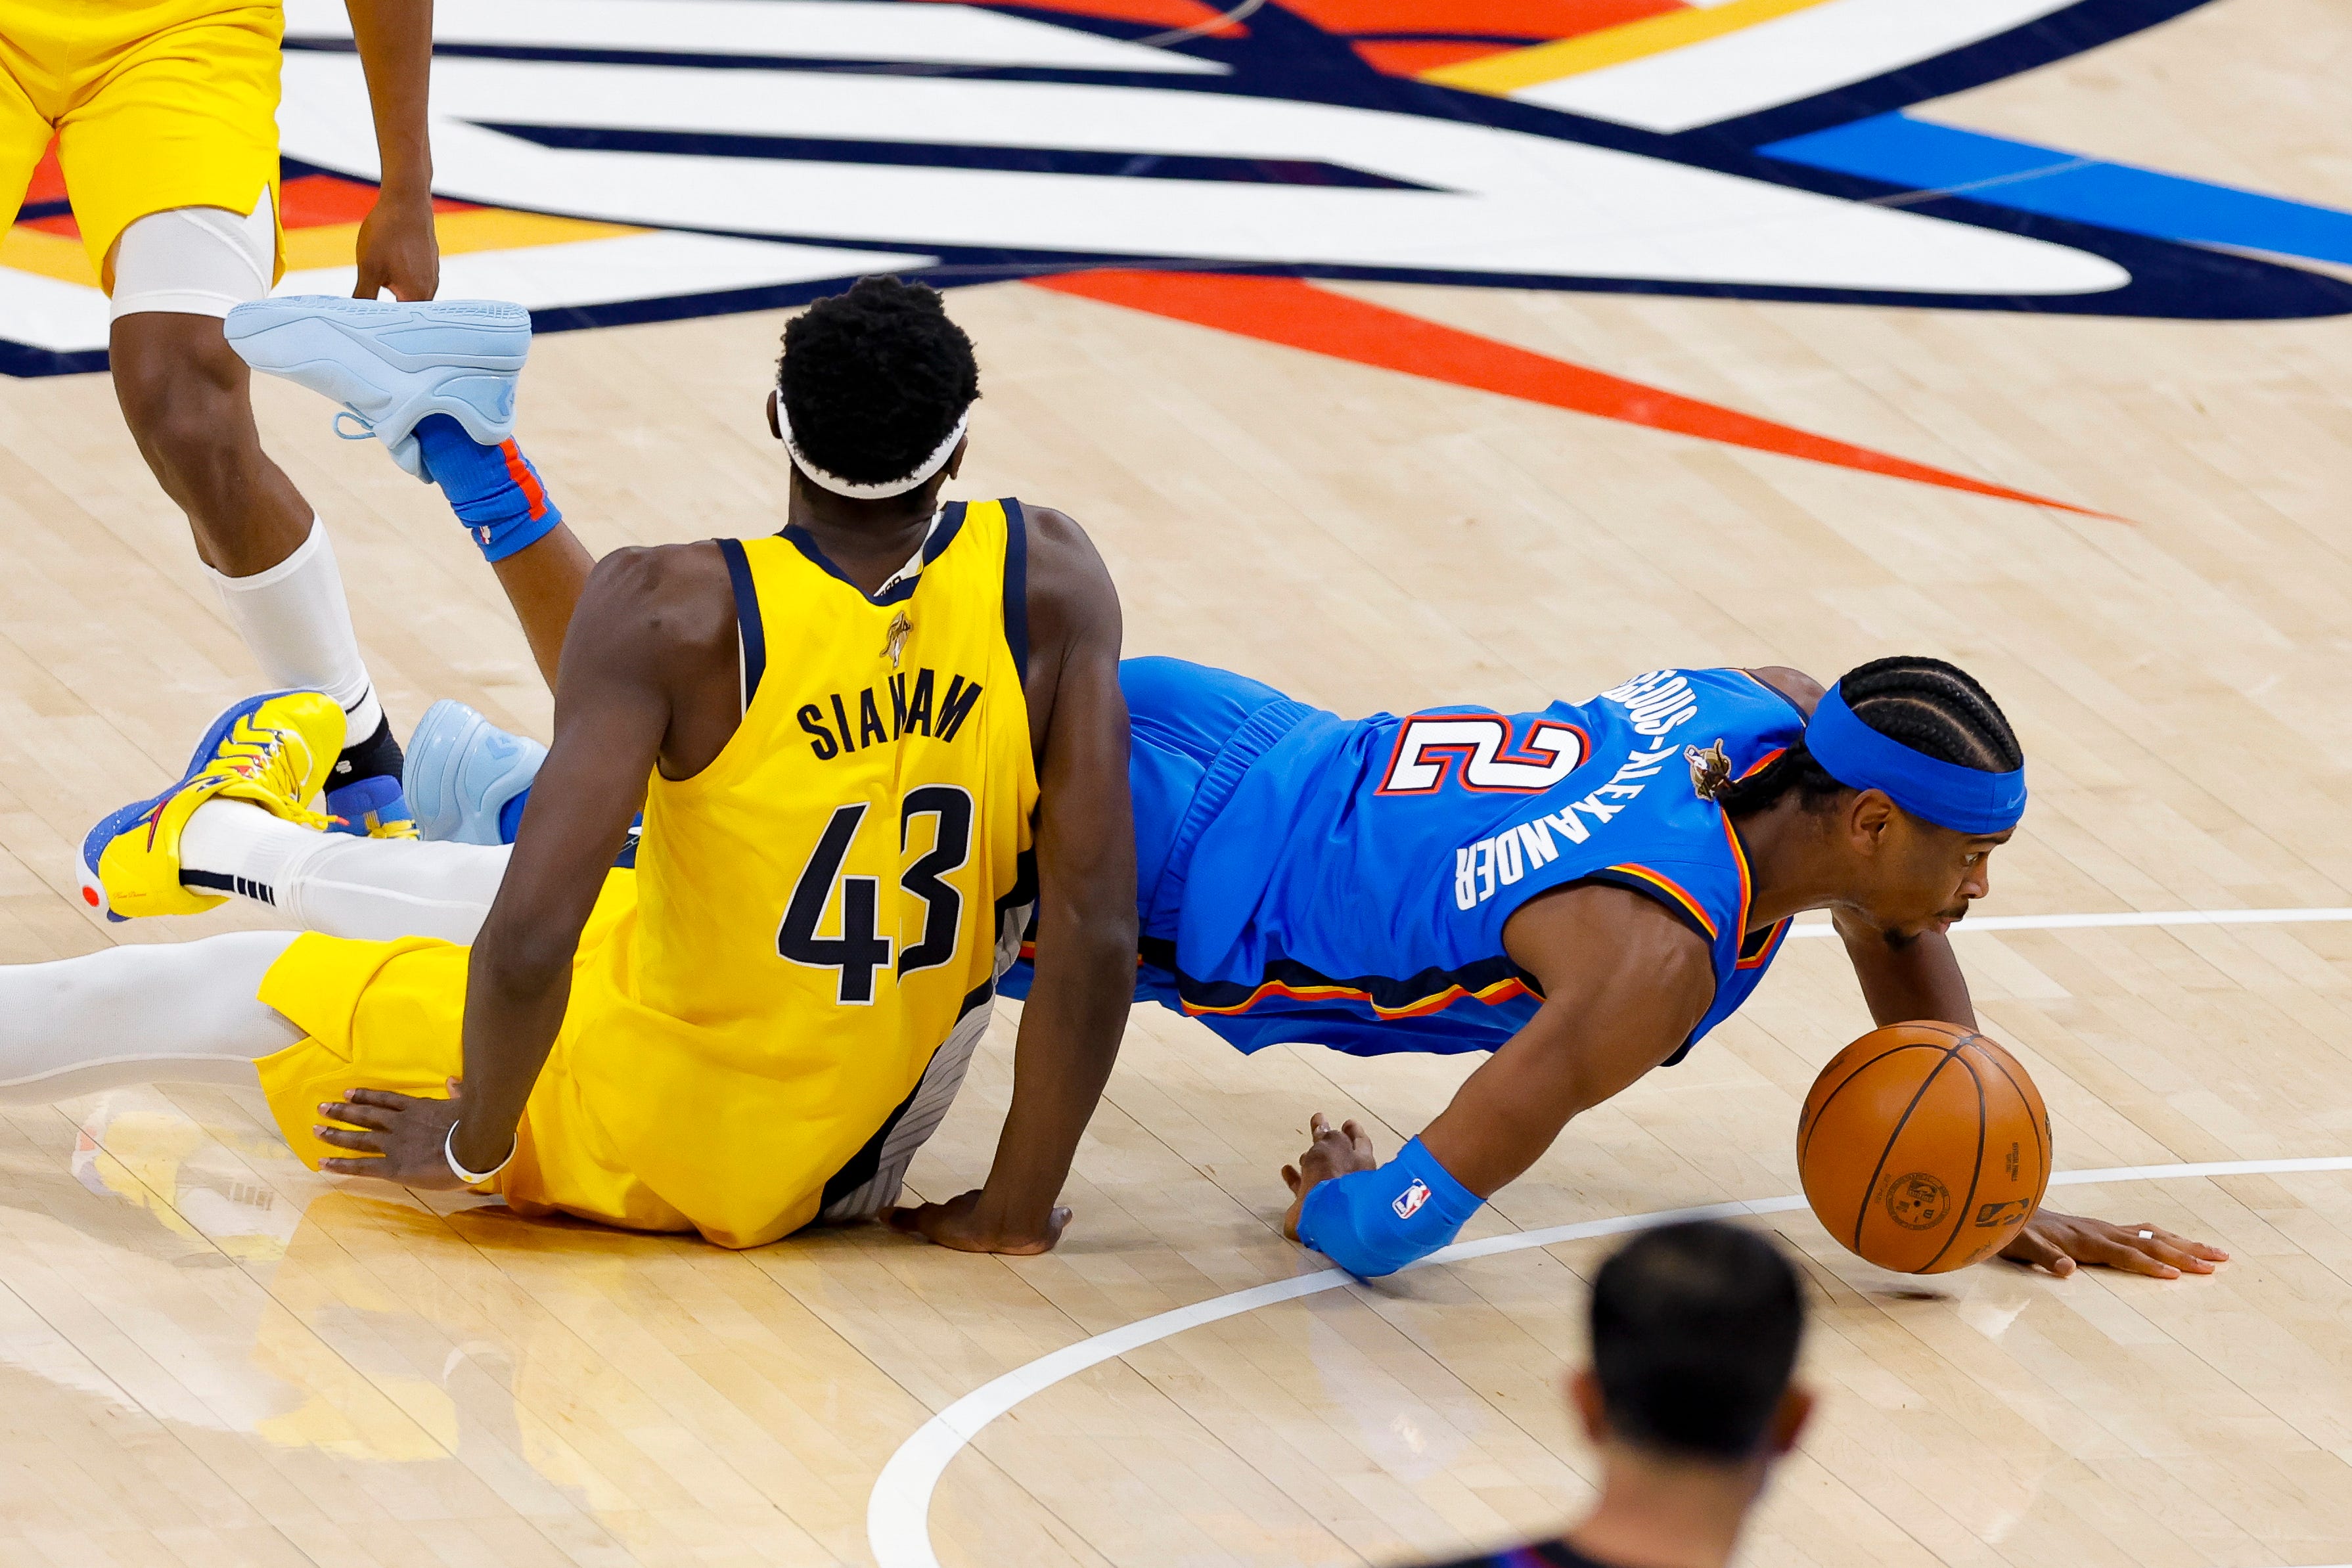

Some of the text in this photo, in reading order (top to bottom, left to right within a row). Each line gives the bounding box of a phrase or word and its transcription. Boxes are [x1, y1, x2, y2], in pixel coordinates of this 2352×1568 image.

[796, 667, 984, 761] SIAKAM
[1374, 714, 1592, 795] 2
[775, 783, 976, 1006] 43
